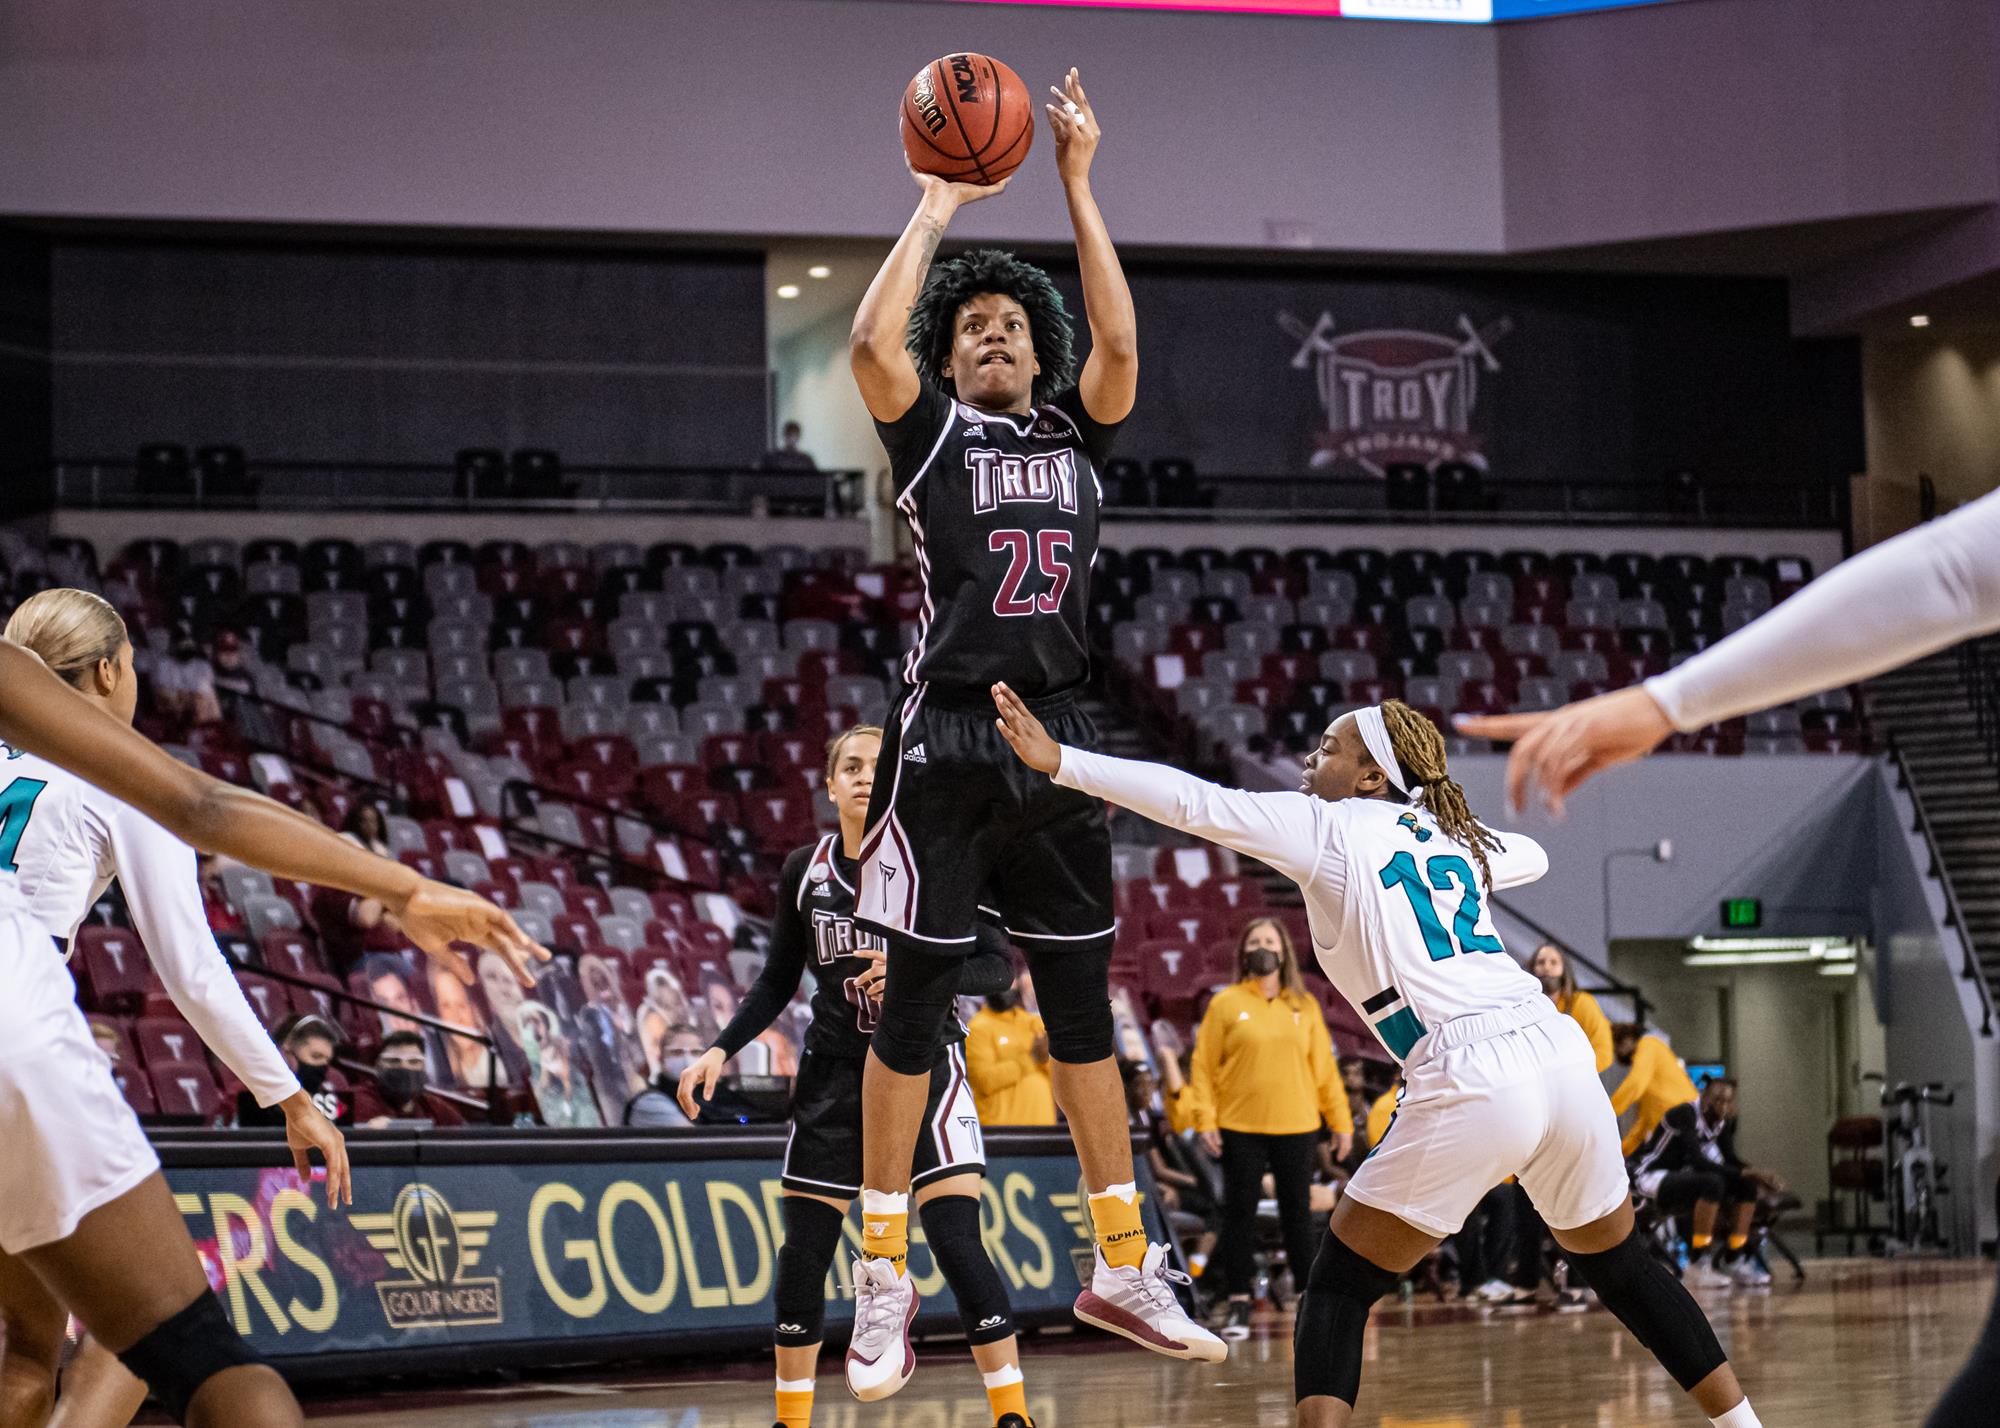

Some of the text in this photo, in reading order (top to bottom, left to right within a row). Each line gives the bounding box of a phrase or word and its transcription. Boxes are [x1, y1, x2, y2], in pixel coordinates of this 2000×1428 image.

[912, 66, 948, 138] Wilso
[949, 54, 979, 103] NCAA
[1340, 369, 1451, 430] TROY
[965, 447, 1078, 515] TROY
[988, 528, 1073, 617] 25
[903, 752, 927, 764] adidas
[812, 908, 888, 966] TRO
[1378, 850, 1505, 963] 12
[174, 1188, 339, 1336] RS
